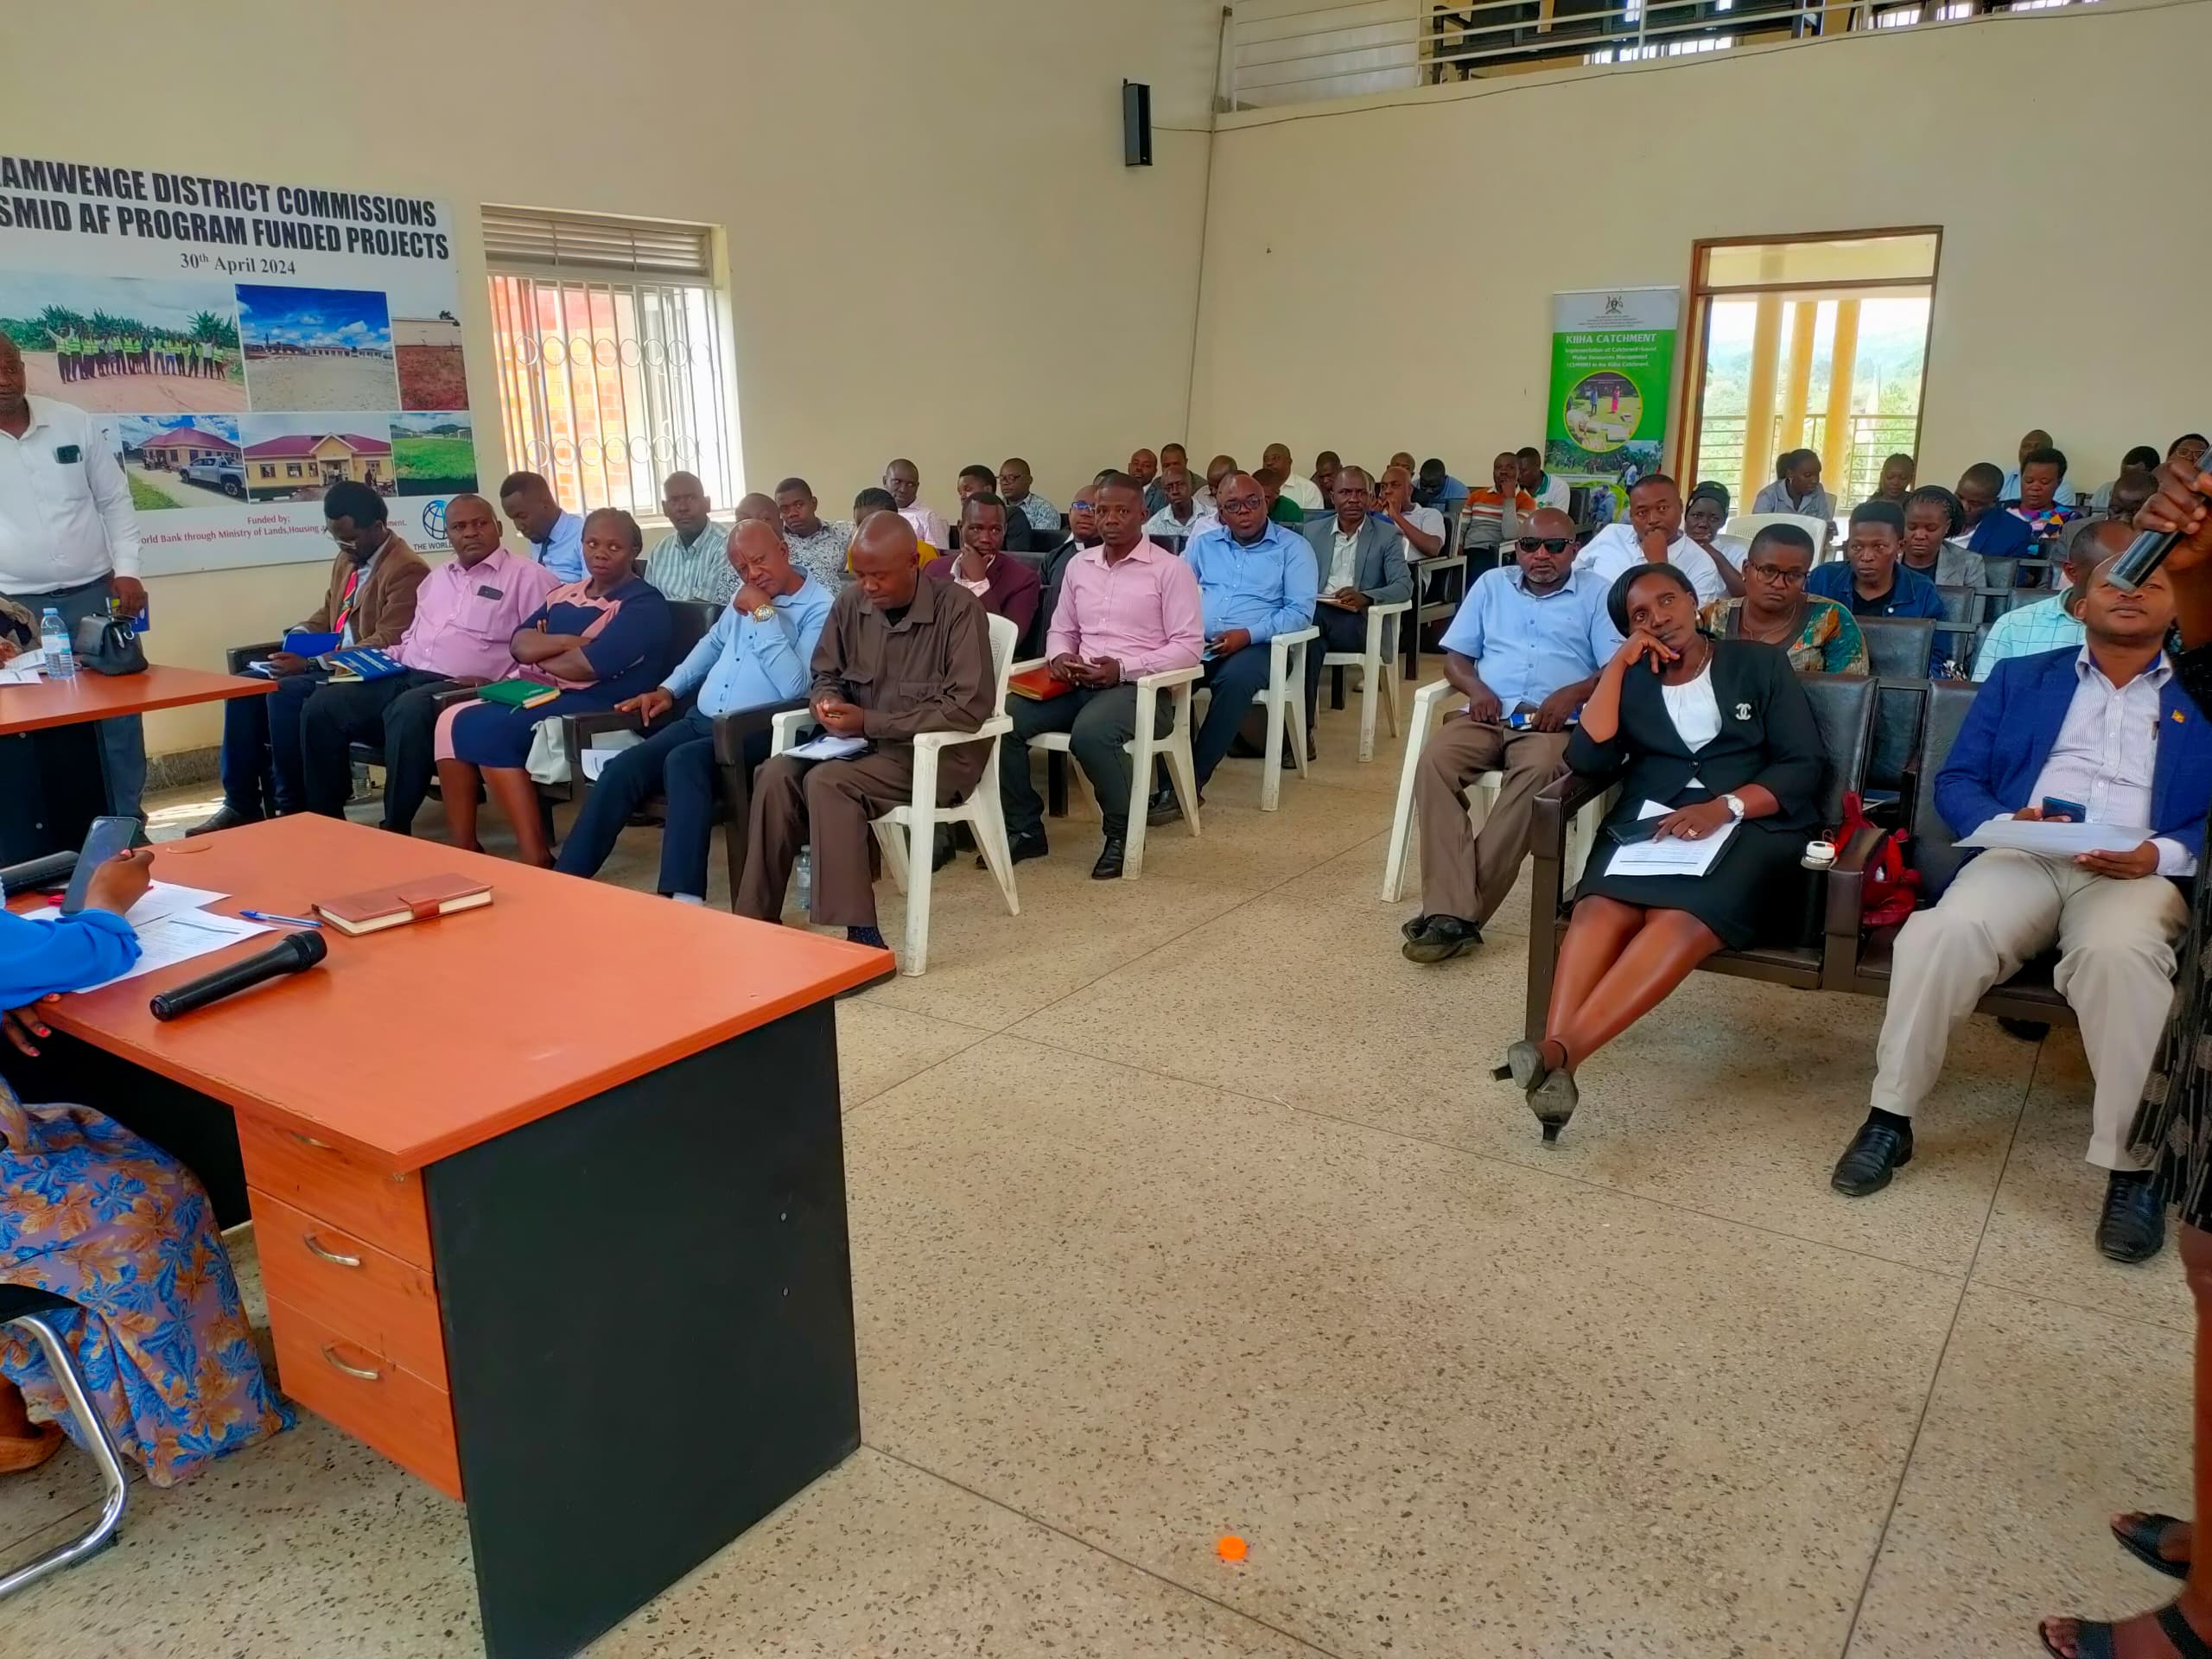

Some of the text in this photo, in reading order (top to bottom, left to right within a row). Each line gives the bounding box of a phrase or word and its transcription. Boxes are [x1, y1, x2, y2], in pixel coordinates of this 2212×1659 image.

[0, 156, 436, 227] AMWENGE DISTRICT COMMISSIONS
[79, 202, 111, 234] AF
[117, 206, 248, 245] PROGRAM
[252, 218, 341, 252] FUNDED
[346, 226, 449, 260] PROJECTS
[214, 256, 256, 275] April
[261, 258, 296, 275] 2024
[1596, 333, 1657, 343] CATCHMENT
[247, 516, 276, 524] Funded
[140, 534, 158, 544] orld
[161, 532, 182, 543] Bank
[184, 531, 216, 542] through
[219, 529, 251, 539] Ministry
[253, 528, 262, 537] of
[414, 543, 428, 551] THE
